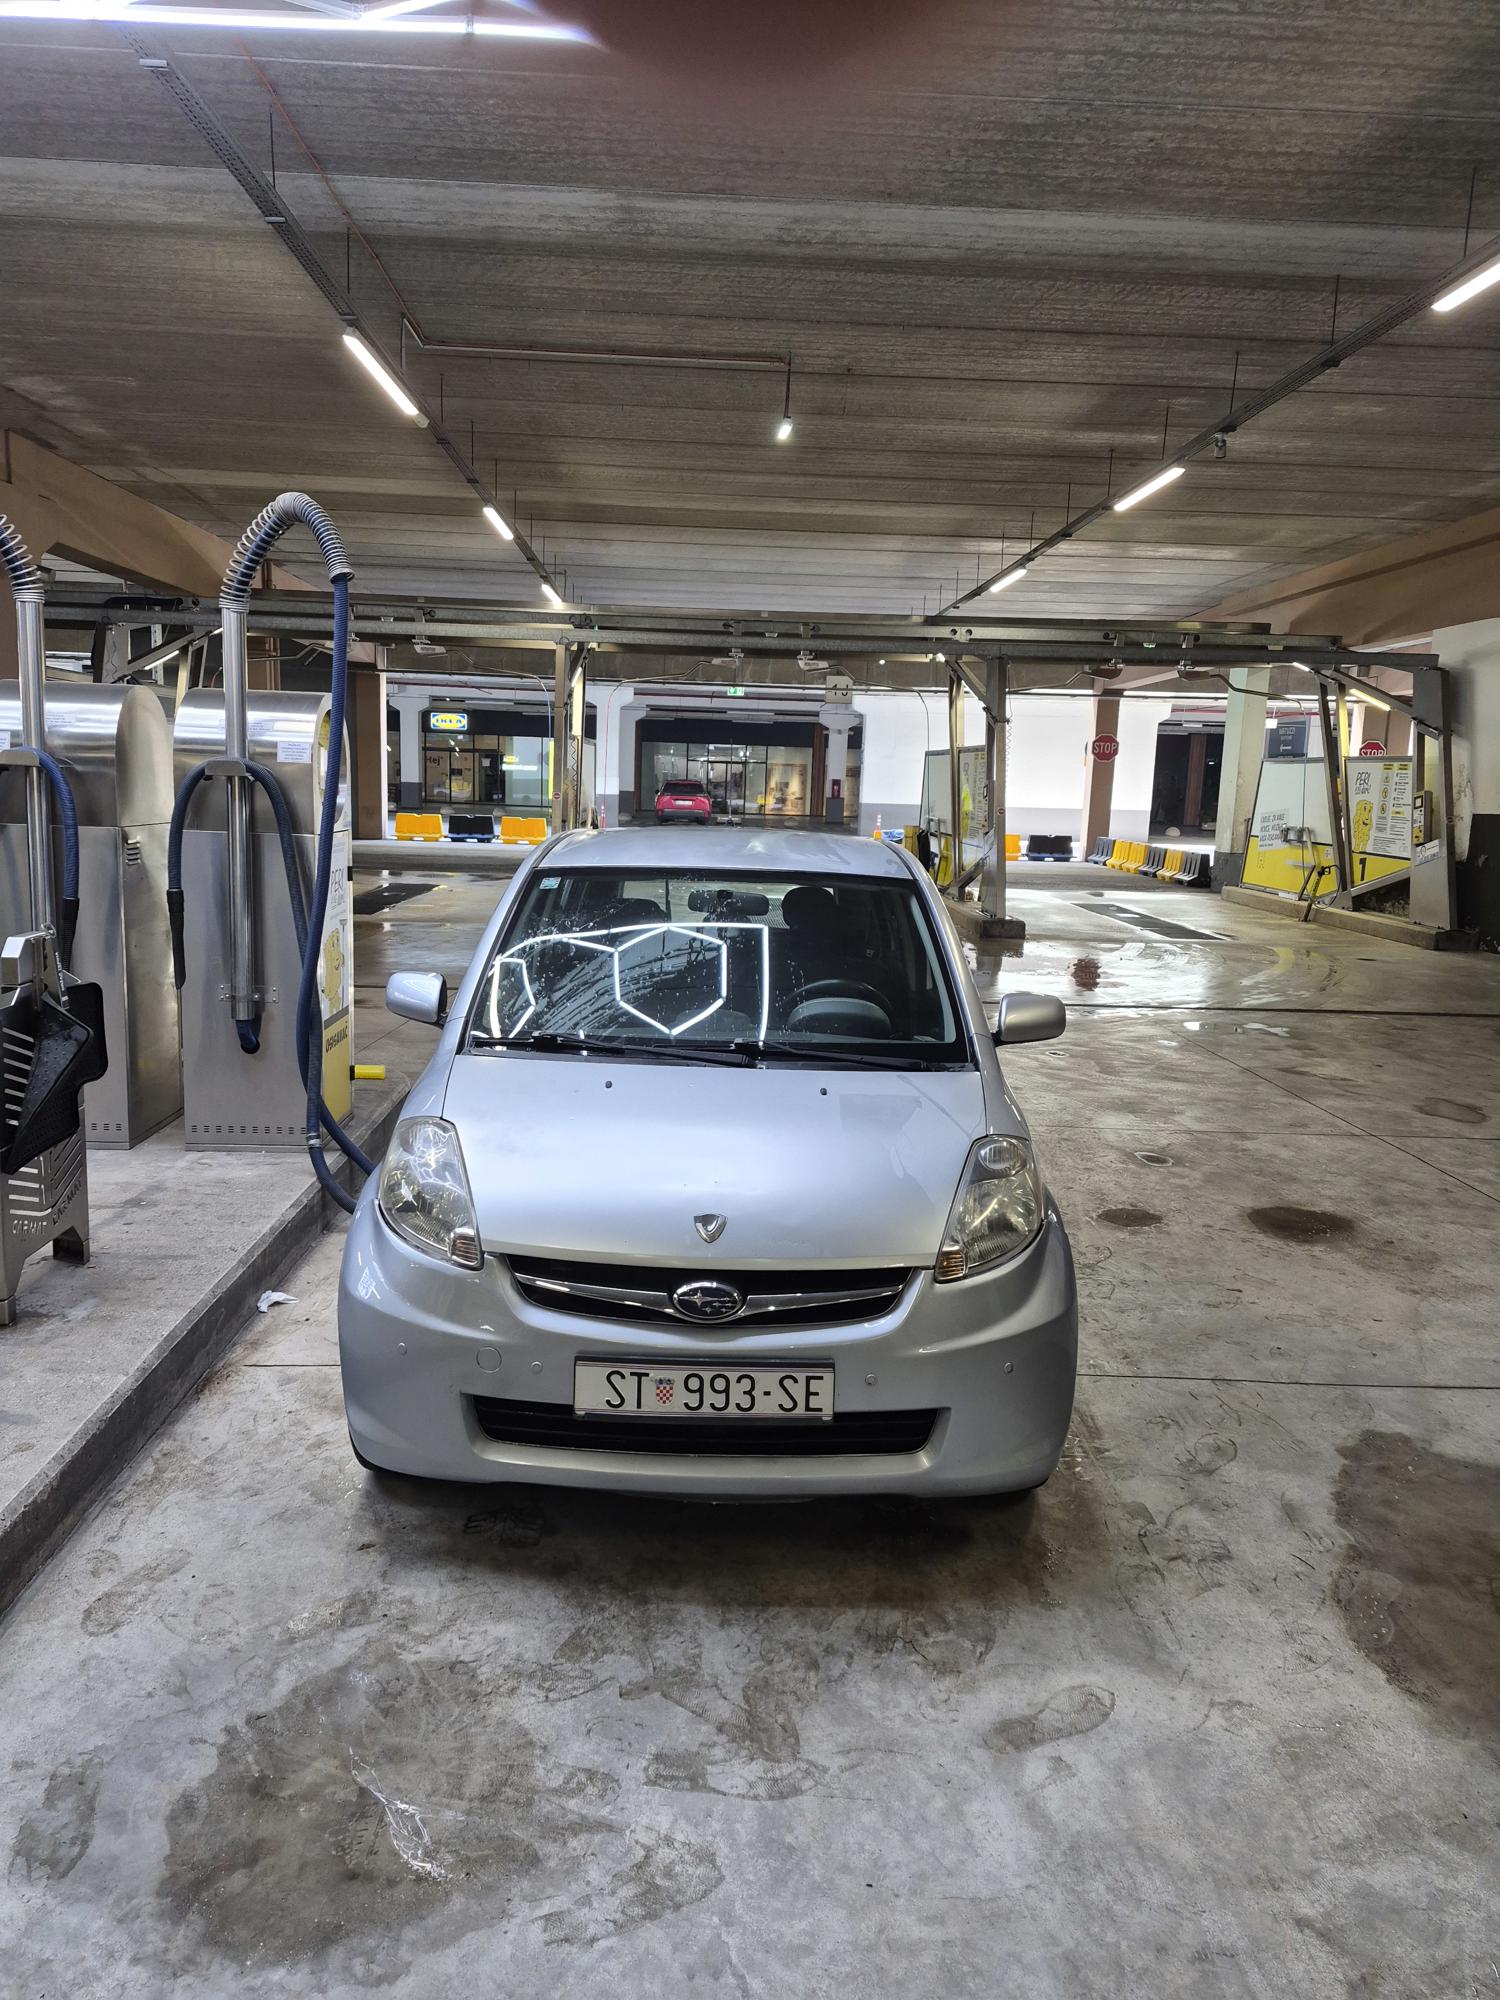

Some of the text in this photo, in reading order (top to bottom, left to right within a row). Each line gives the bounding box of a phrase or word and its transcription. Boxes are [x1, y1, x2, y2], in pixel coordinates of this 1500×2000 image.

[1093, 742, 1117, 753] STOP
[1359, 858, 1367, 881] 1
[605, 1370, 650, 1409] ST
